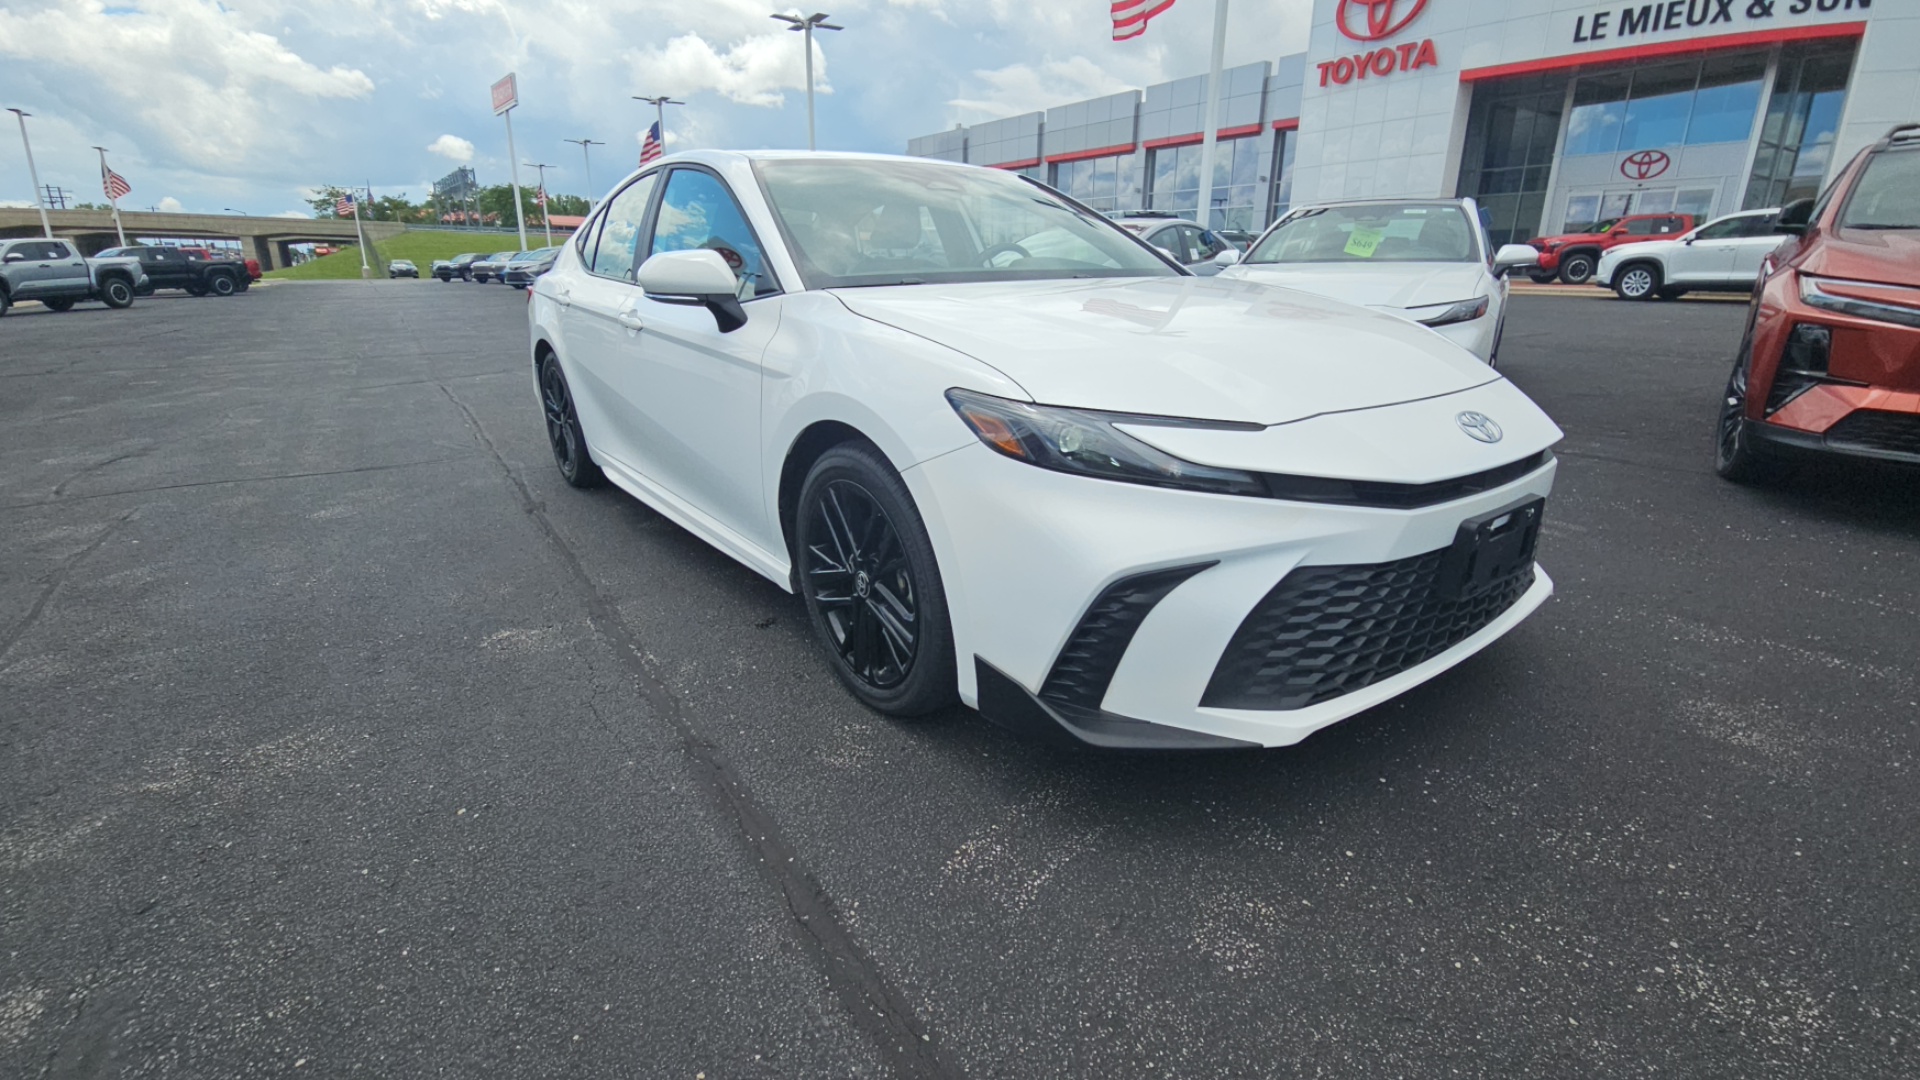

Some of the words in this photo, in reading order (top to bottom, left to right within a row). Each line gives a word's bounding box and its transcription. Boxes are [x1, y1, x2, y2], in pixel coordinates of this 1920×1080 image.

[1573, 12, 1610, 43] LE
[1618, 0, 1733, 37] MIEUX
[1746, 0, 1774, 19] &
[1317, 38, 1438, 88] TOYOTA
